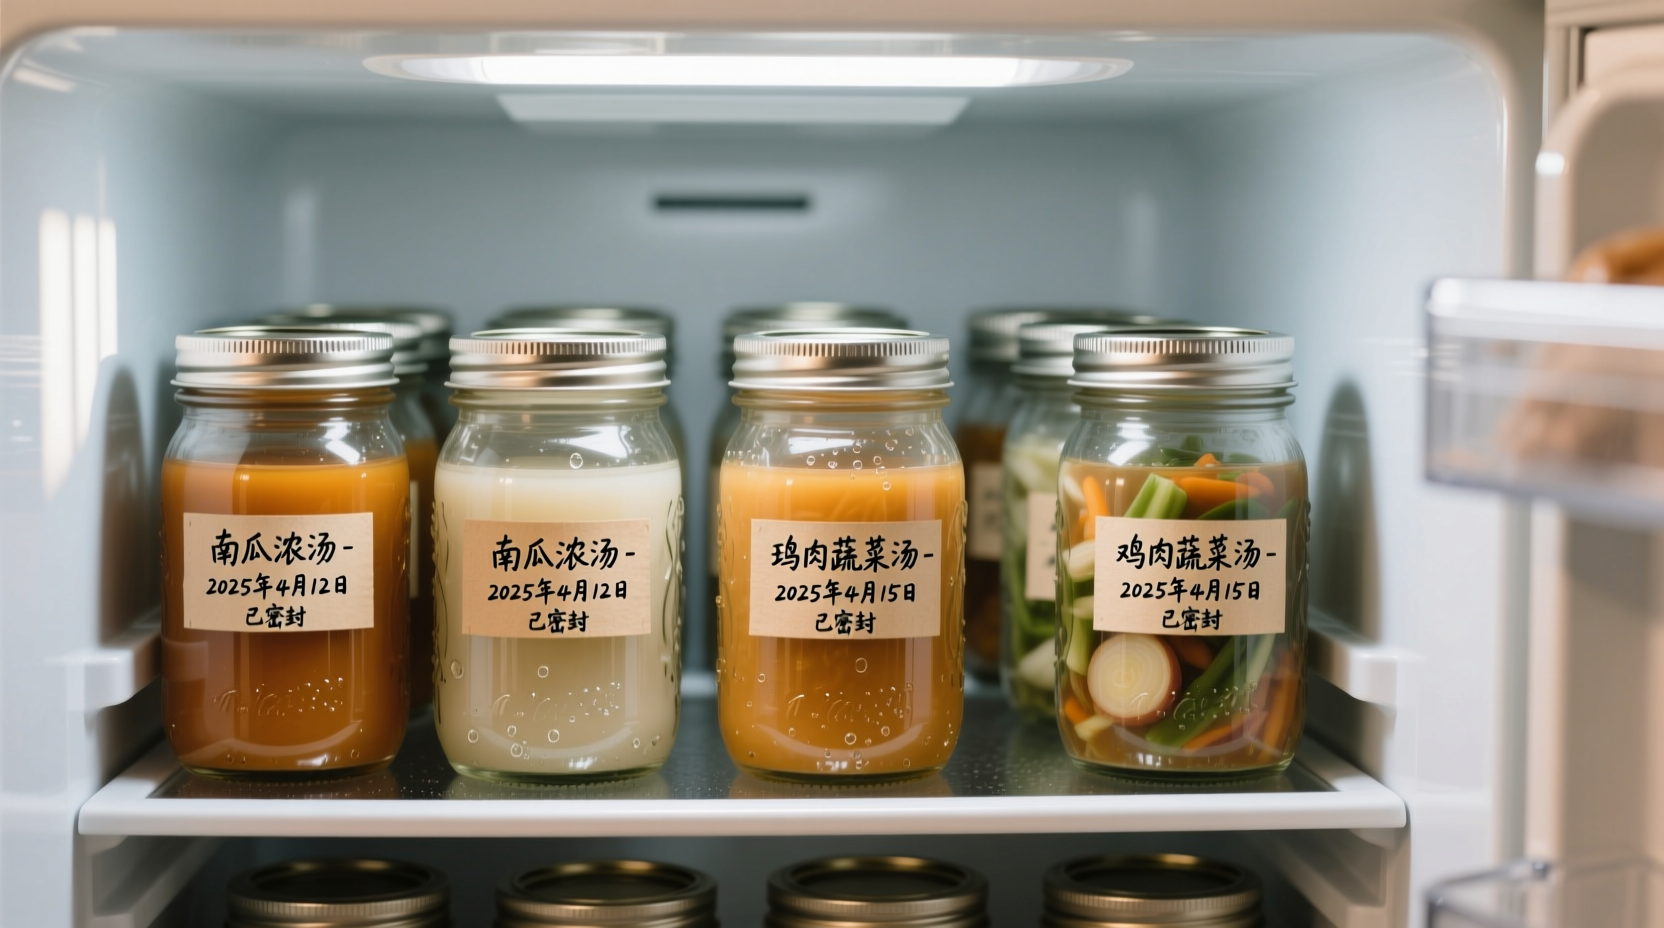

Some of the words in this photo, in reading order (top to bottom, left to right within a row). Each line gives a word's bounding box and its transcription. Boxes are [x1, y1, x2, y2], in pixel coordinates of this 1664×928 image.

[205, 572, 347, 600] 2025年4月12日
[487, 577, 627, 606] 2025年4月12日
[774, 578, 916, 606] 2025年4月15日
[1119, 576, 1260, 604] 2025年4月15日
